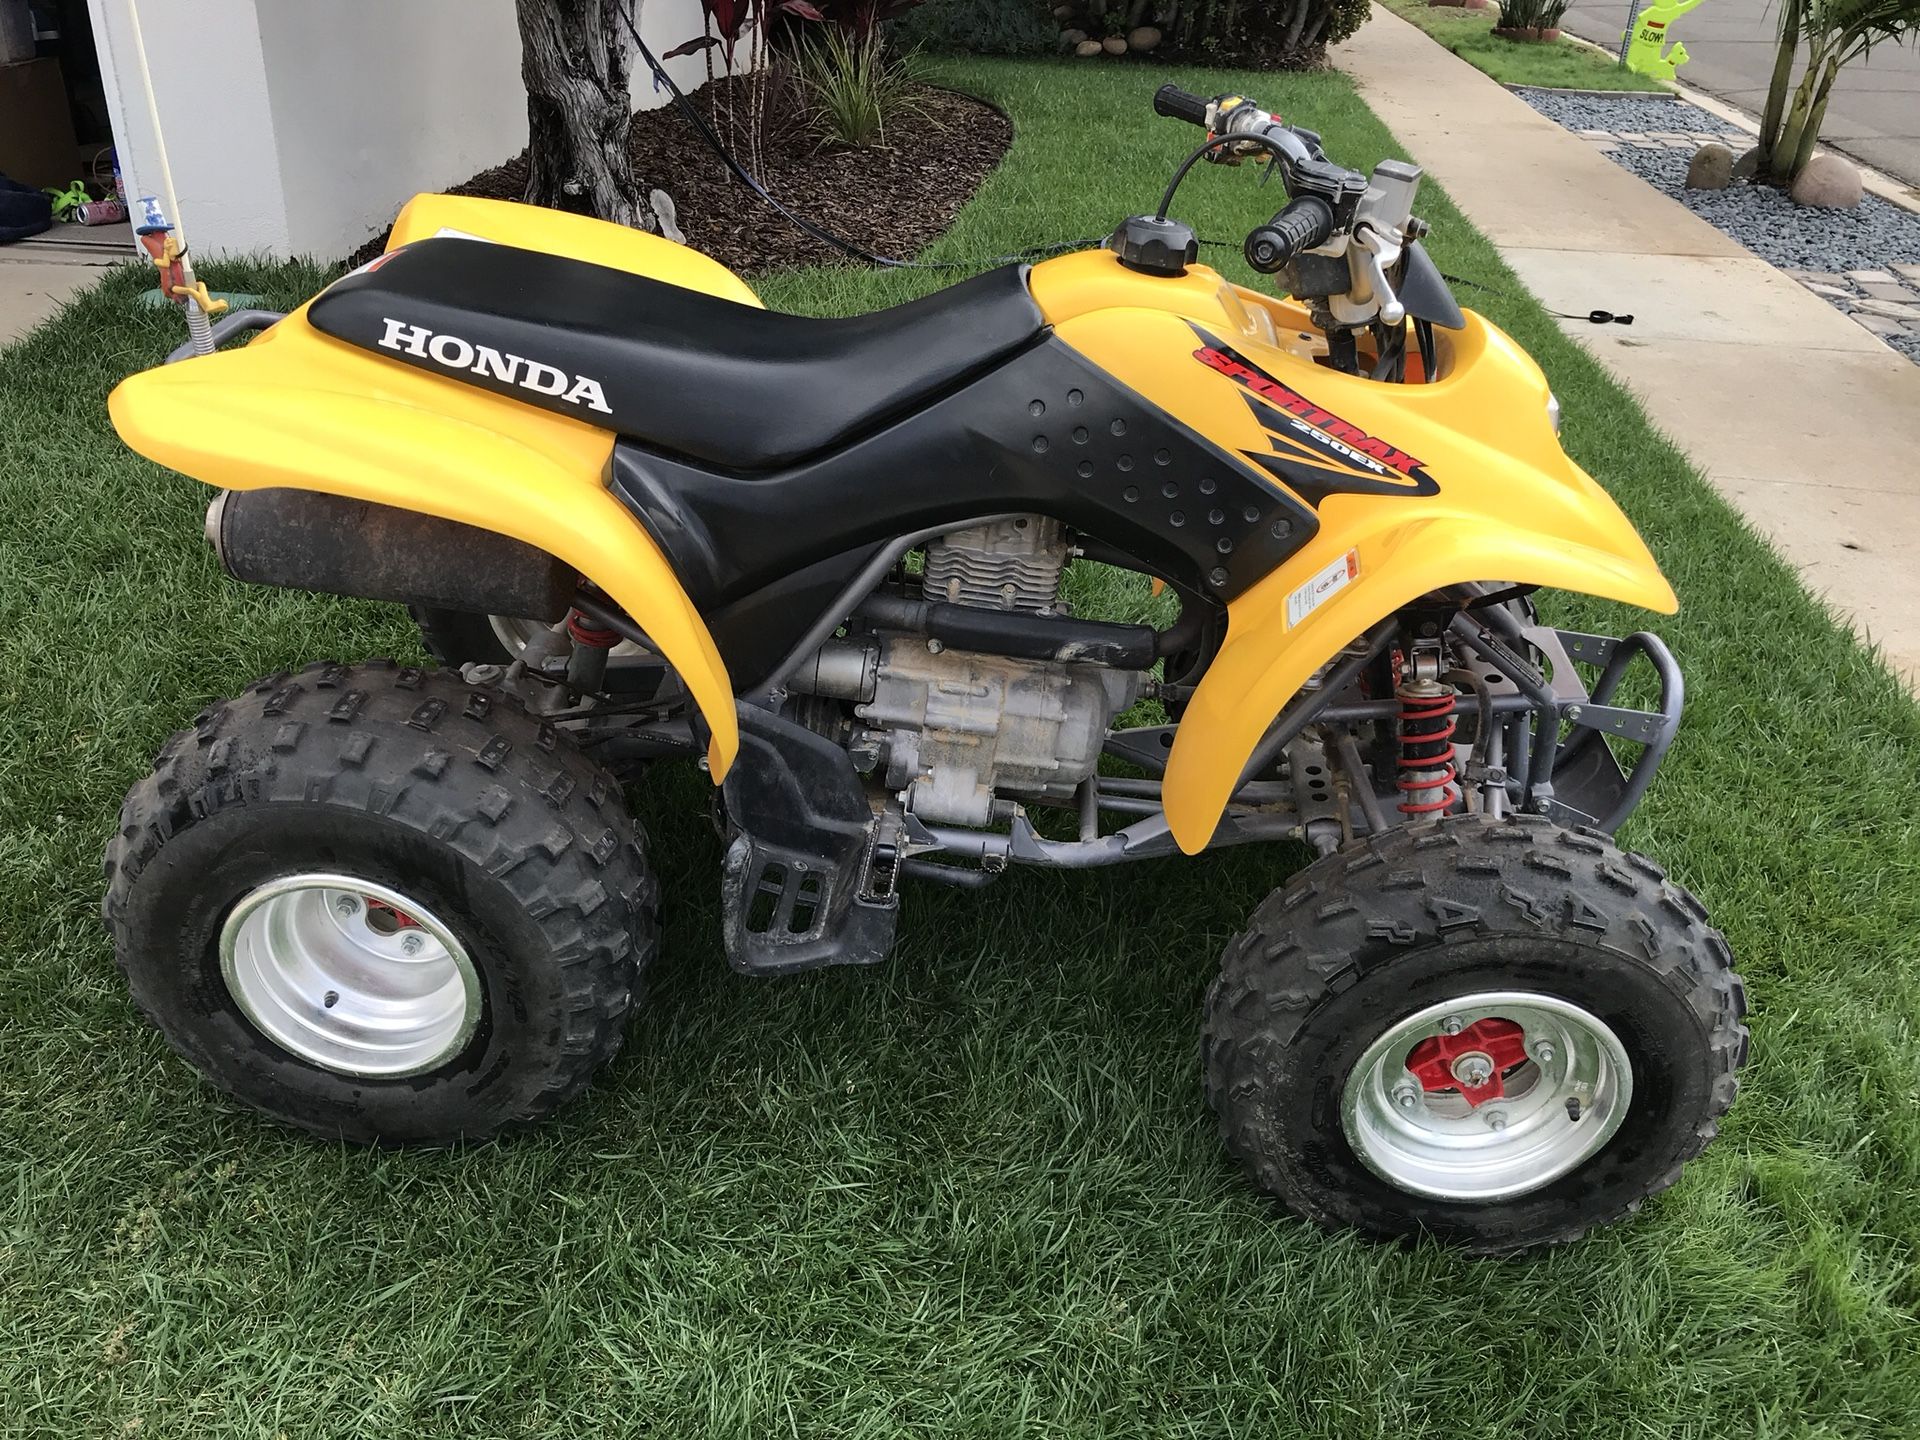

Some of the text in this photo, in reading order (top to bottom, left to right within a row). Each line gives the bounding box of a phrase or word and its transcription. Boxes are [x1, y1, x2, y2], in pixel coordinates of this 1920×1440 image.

[378, 318, 613, 414] HONDA
[1192, 346, 1428, 474] SPORTRAX
[1290, 418, 1386, 475] 250EX
